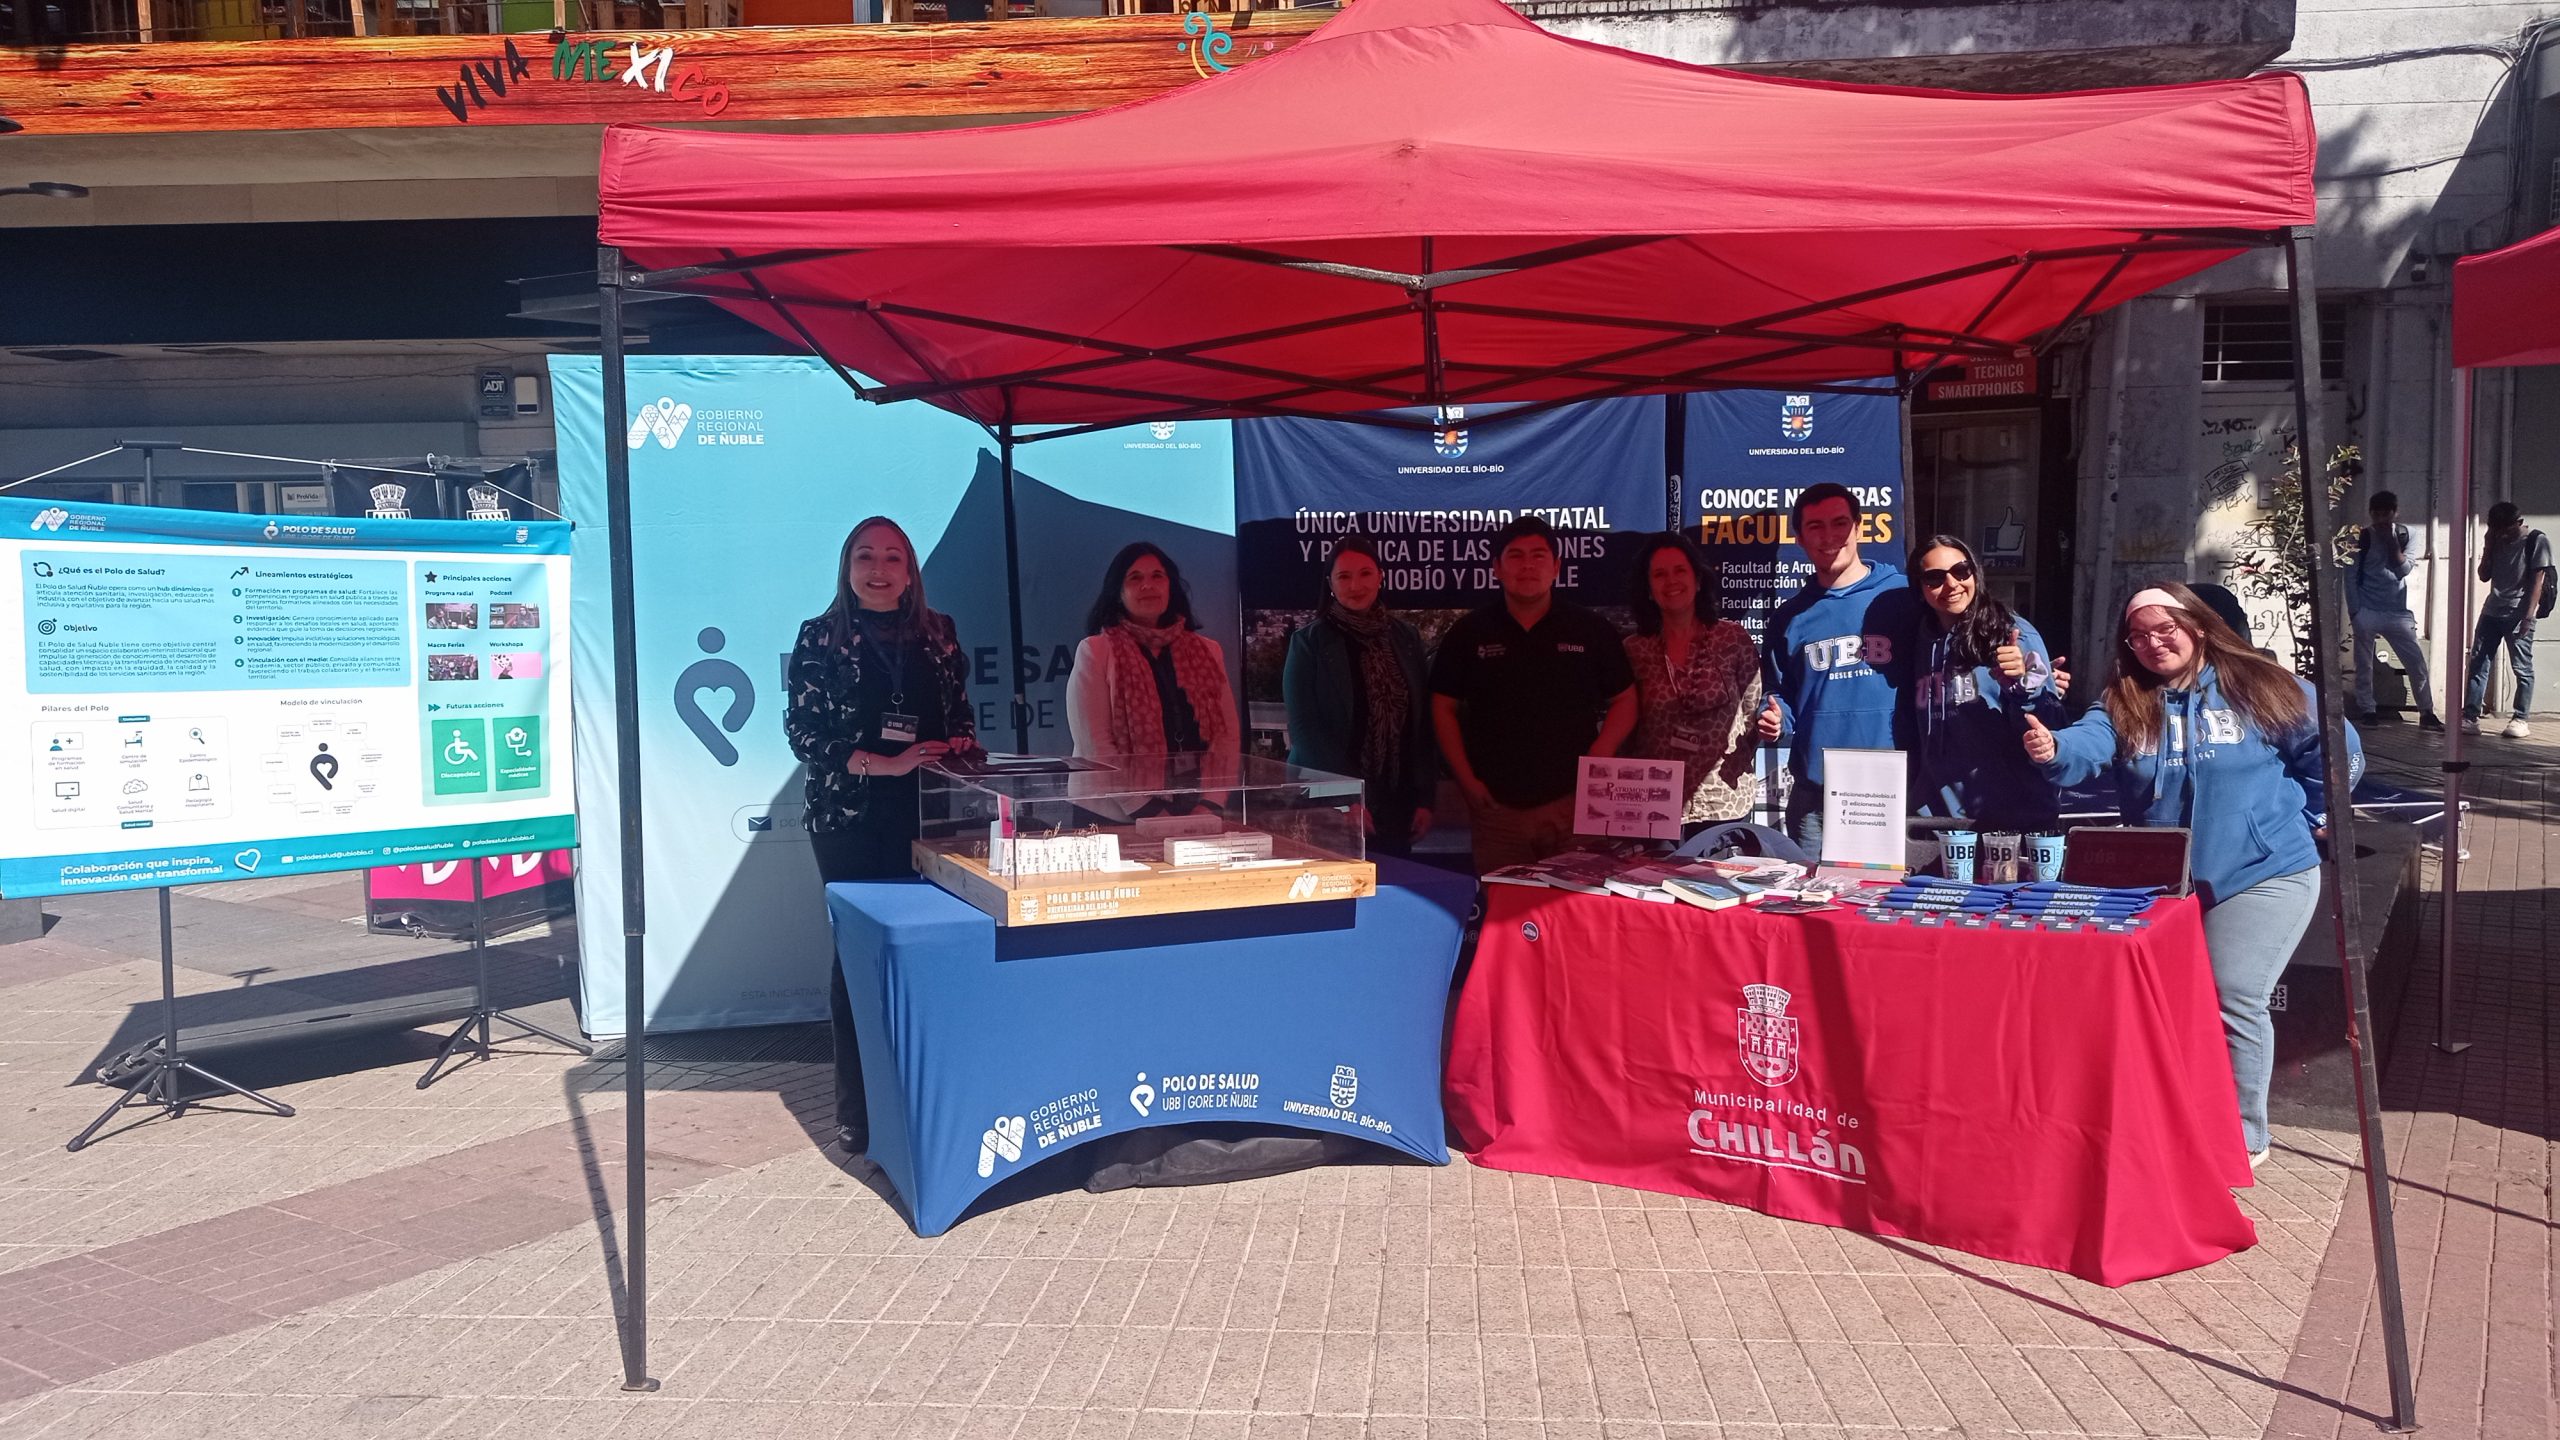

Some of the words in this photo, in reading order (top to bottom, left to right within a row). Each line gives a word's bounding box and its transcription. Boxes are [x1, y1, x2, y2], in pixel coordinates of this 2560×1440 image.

[436, 37, 530, 122] VIVA
[551, 37, 730, 116] MEXICO
[1974, 363, 2024, 379] TECNICO
[484, 380, 505, 391] ADT
[1938, 381, 2024, 399] SMARTPHONES
[696, 410, 763, 420] GOBIERNO
[697, 421, 764, 431] REGIONAL
[697, 434, 717, 445] DE
[719, 431, 765, 445] ÑUBLE
[1749, 447, 1799, 455] UNIVERSIDAD
[1799, 447, 1815, 455] DEL
[1816, 446, 1845, 454] BÍO-BÍO
[1398, 466, 1453, 474] UNIVERSIDAD
[1472, 464, 1505, 473] BÍO-BÍO
[1700, 488, 1778, 509] CONOCE
[1295, 507, 1361, 534] ÚNICA
[1367, 509, 1513, 534] UNIVERSIDAD
[1701, 512, 1893, 545] FACULES
[282, 525, 310, 533] POLO
[310, 526, 324, 534] DE
[324, 527, 356, 535] SALUD
[1299, 540, 1313, 562] Y
[1418, 540, 1445, 562] DE
[1452, 539, 1491, 562] LAS
[58, 566, 81, 575] ¿Qué
[137, 568, 166, 576] Salud?
[1722, 560, 1771, 574] Facultad
[1775, 561, 1789, 573] de
[307, 572, 353, 580] estratégicos
[1452, 568, 1466, 590] Y
[1721, 576, 1798, 588] Construcción
[1721, 596, 1771, 609] Facultad
[1804, 634, 1893, 672] UBB
[1854, 668, 1873, 677] 1947
[320, 697, 363, 705] vinculación
[1848, 810, 1886, 818] edicionesubb
[1945, 844, 1975, 860] UBB
[60, 861, 142, 877] ¡Colaboración
[146, 859, 170, 869] que
[171, 856, 213, 867] inspira,
[60, 873, 128, 886] innovación
[130, 870, 154, 882] que
[1046, 893, 1069, 904] POLO
[1084, 889, 1112, 902] SALUD
[1923, 887, 1971, 895] MUNDO
[2043, 908, 2095, 917] MUNDO
[1162, 1075, 1197, 1093] POLO
[1199, 1074, 1216, 1091] DE
[1217, 1073, 1260, 1091] SALUD
[1030, 1088, 1098, 1122] GOBIERNO
[1162, 1096, 1181, 1112] UBB
[1187, 1095, 1214, 1110] GORE
[1216, 1094, 1229, 1108] DE
[1230, 1090, 1259, 1109] ÑUBLE
[1694, 1089, 1827, 1122] Municipalidad
[1837, 1112, 1859, 1129] de
[1034, 1102, 1100, 1135] REGIONAL
[1283, 1100, 1341, 1119] UNIVERSIDAD
[1341, 1110, 1358, 1123] DEL
[1359, 1114, 1393, 1134] BÍO-BÍO
[1037, 1132, 1058, 1149] DE
[1058, 1114, 1103, 1141] ÑUBLE
